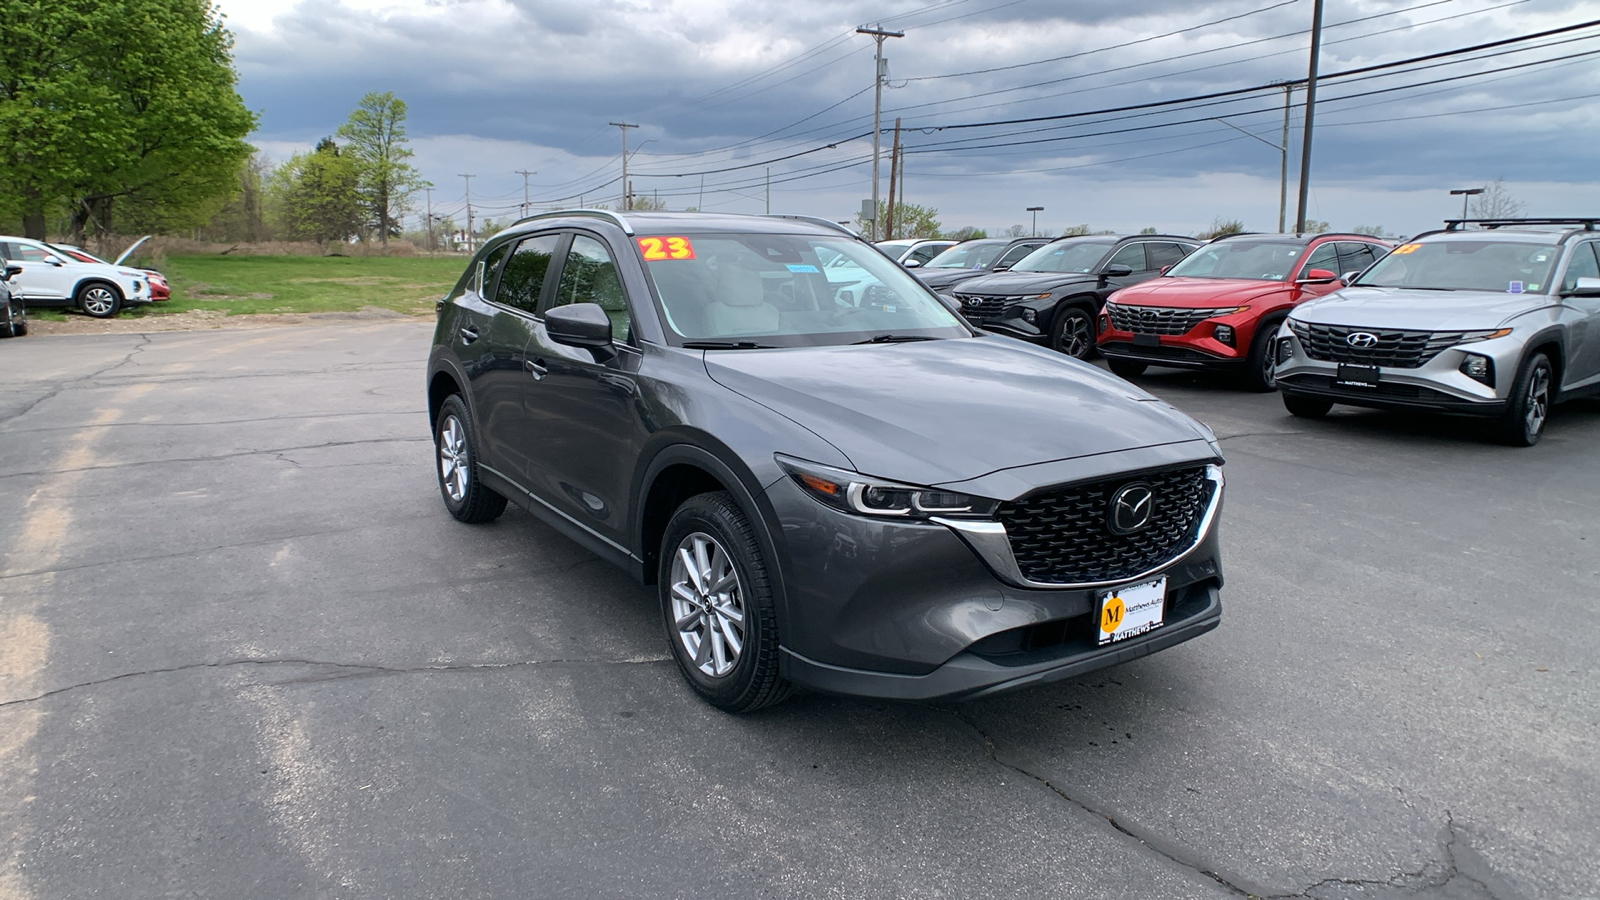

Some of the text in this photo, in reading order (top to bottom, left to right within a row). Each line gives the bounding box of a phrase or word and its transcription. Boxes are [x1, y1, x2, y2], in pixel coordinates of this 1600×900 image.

[640, 237, 691, 259] 23
[1104, 605, 1121, 626] M
[1113, 624, 1151, 642] MATTHEWS
